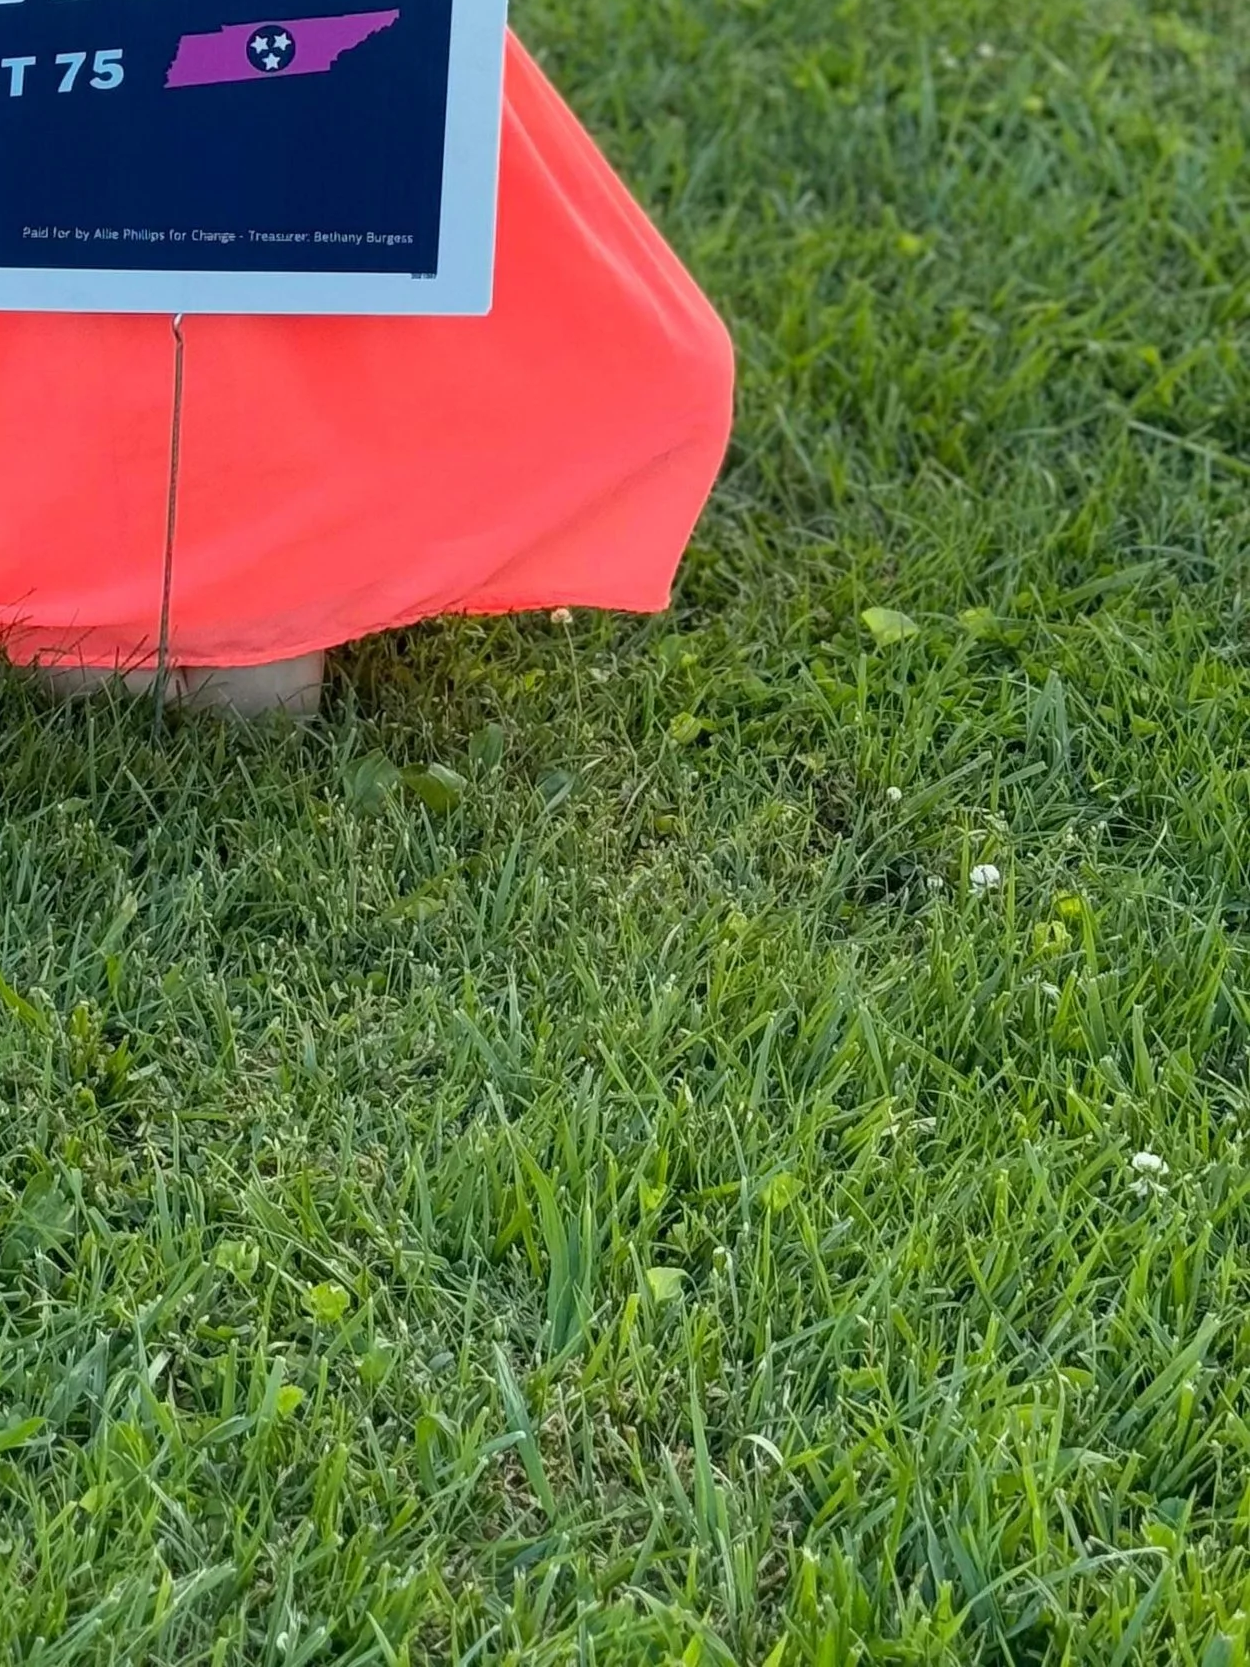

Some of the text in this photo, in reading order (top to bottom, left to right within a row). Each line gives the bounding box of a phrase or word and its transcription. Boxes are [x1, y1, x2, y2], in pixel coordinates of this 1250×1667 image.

[54, 48, 125, 94] 75
[22, 226, 49, 239] Paid
[52, 226, 71, 239] for
[75, 227, 90, 242] by
[93, 228, 120, 240] Allie
[122, 228, 166, 243] Phillips
[168, 229, 188, 242] for
[191, 230, 237, 245] Change
[248, 230, 311, 243] Treasurer:
[313, 231, 363, 246] Bethany
[366, 232, 414, 246] Burgess
